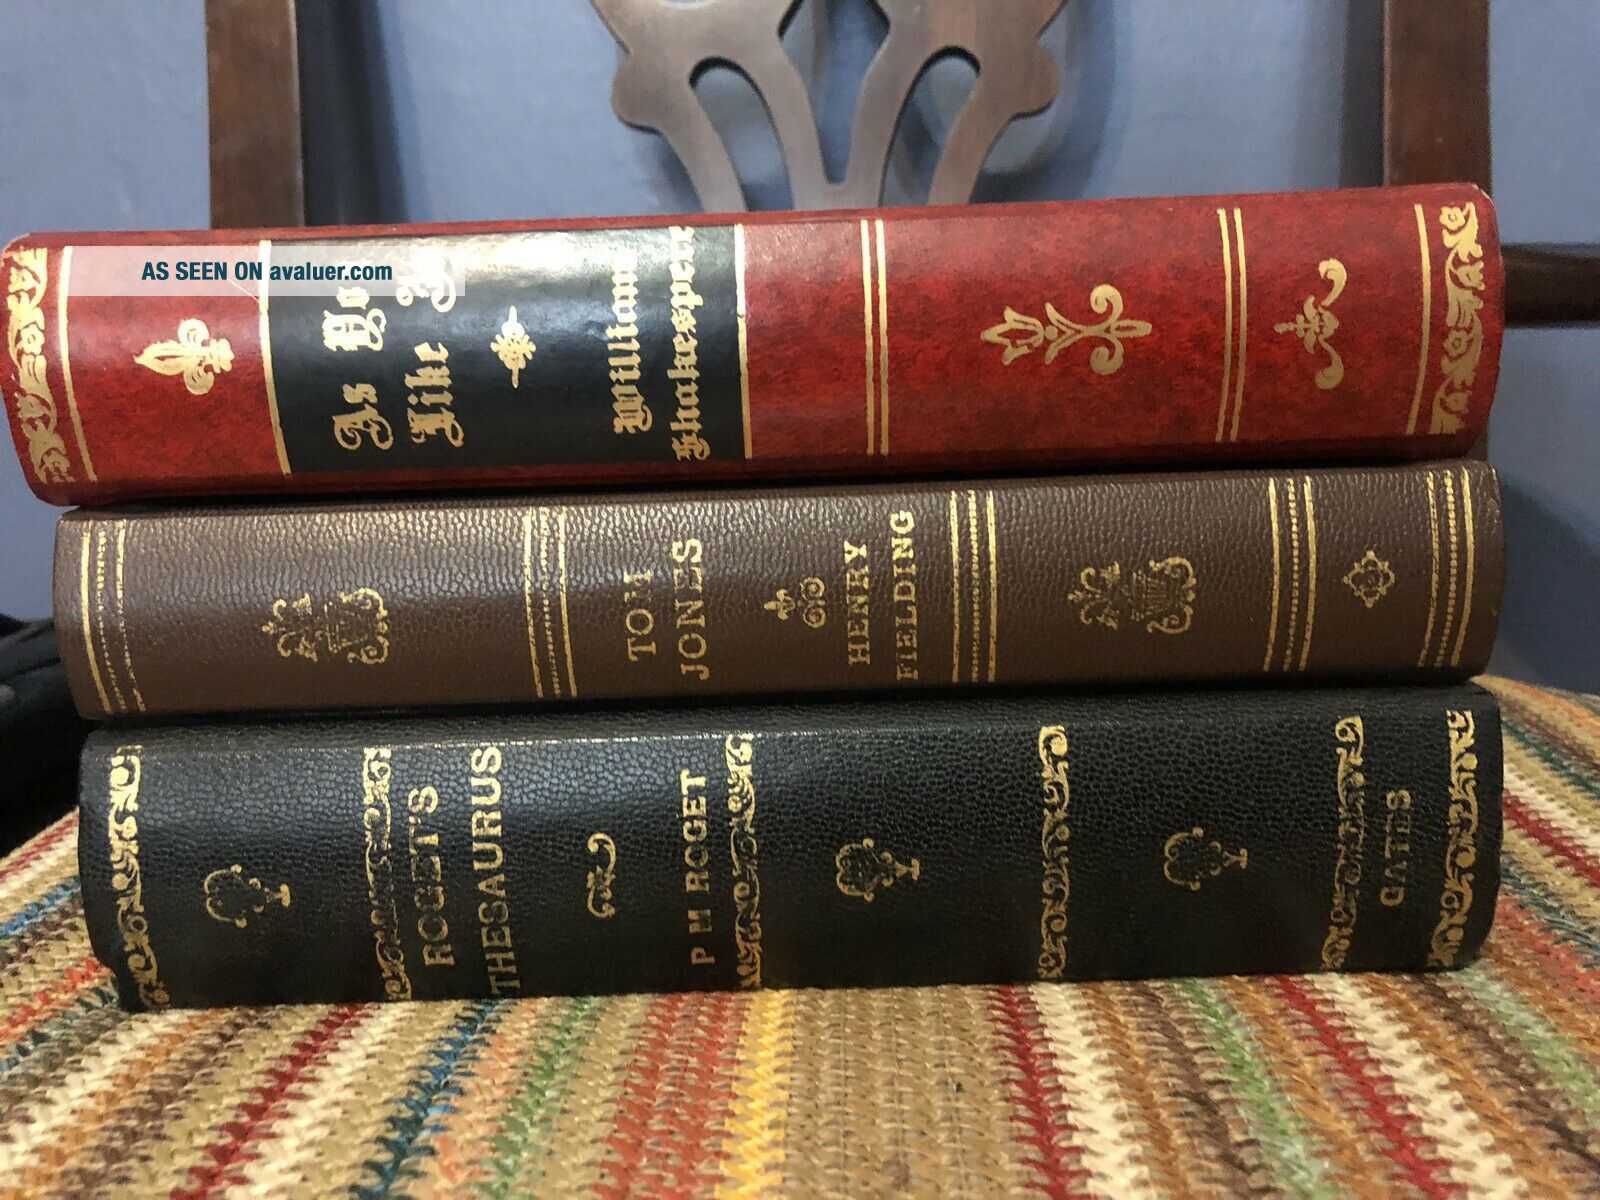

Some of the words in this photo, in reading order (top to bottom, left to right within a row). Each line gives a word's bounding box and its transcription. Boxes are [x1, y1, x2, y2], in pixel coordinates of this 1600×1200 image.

[404, 341, 464, 448] Like
[605, 247, 653, 434] William
[666, 225, 711, 461] Shakespere
[331, 382, 394, 450] As
[623, 569, 657, 663] TOM
[671, 537, 710, 681] JONES
[843, 540, 871, 666] HENRY
[890, 509, 919, 681] FIELDING
[407, 785, 455, 967] ROGET'S
[470, 745, 521, 995] THESAURUS
[679, 767, 711, 893] ROGET
[690, 946, 716, 966] P
